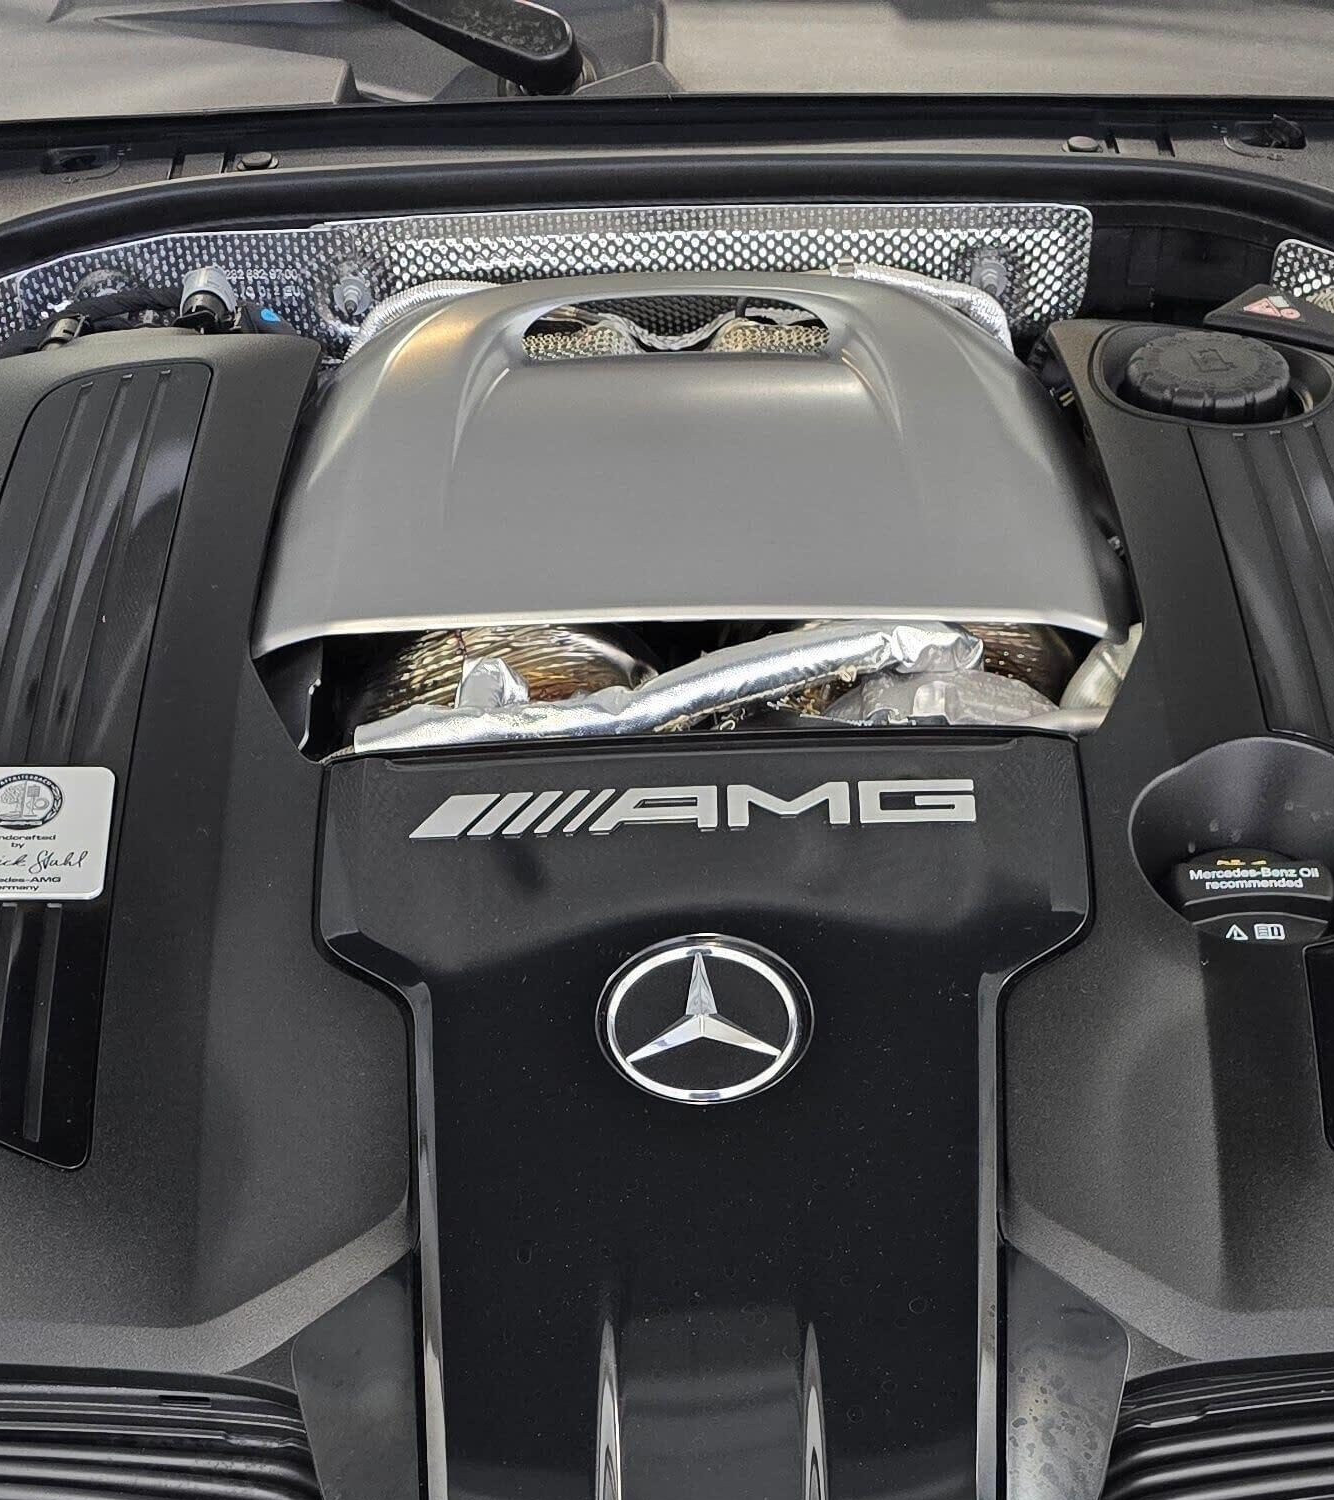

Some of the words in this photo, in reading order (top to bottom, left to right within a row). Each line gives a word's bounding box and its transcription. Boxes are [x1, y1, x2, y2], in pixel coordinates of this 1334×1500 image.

[588, 778, 977, 834] AMG
[1188, 866, 1297, 881] Mercedes-Benz
[1299, 867, 1320, 878] Oil
[1205, 877, 1304, 890] recommended
